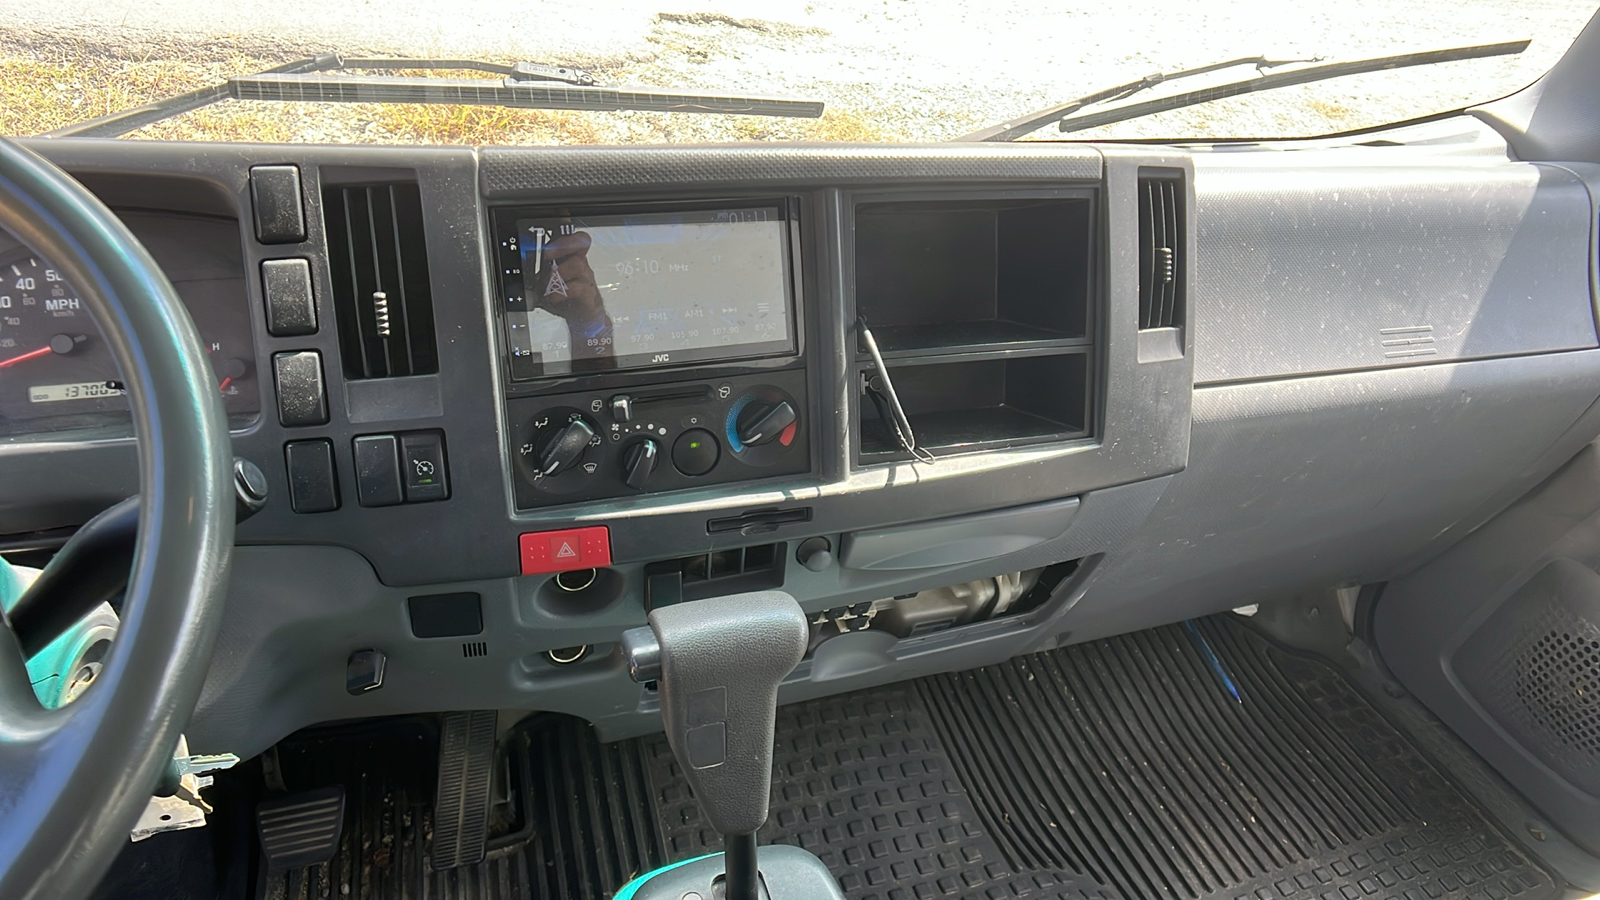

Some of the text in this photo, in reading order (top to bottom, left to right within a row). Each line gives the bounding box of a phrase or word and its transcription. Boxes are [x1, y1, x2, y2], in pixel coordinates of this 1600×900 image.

[669, 263, 690, 272] MHz
[15, 277, 35, 290] 40
[0, 296, 11, 308] 0
[45, 298, 80, 310] MPH
[648, 312, 668, 321] FM1
[684, 309, 704, 318] AM1
[671, 330, 699, 339] 105.90
[712, 326, 739, 335] 107.90
[212, 342, 220, 351] H
[542, 341, 568, 350] 87.90
[587, 337, 612, 347] 89.90
[652, 354, 670, 362] JVC
